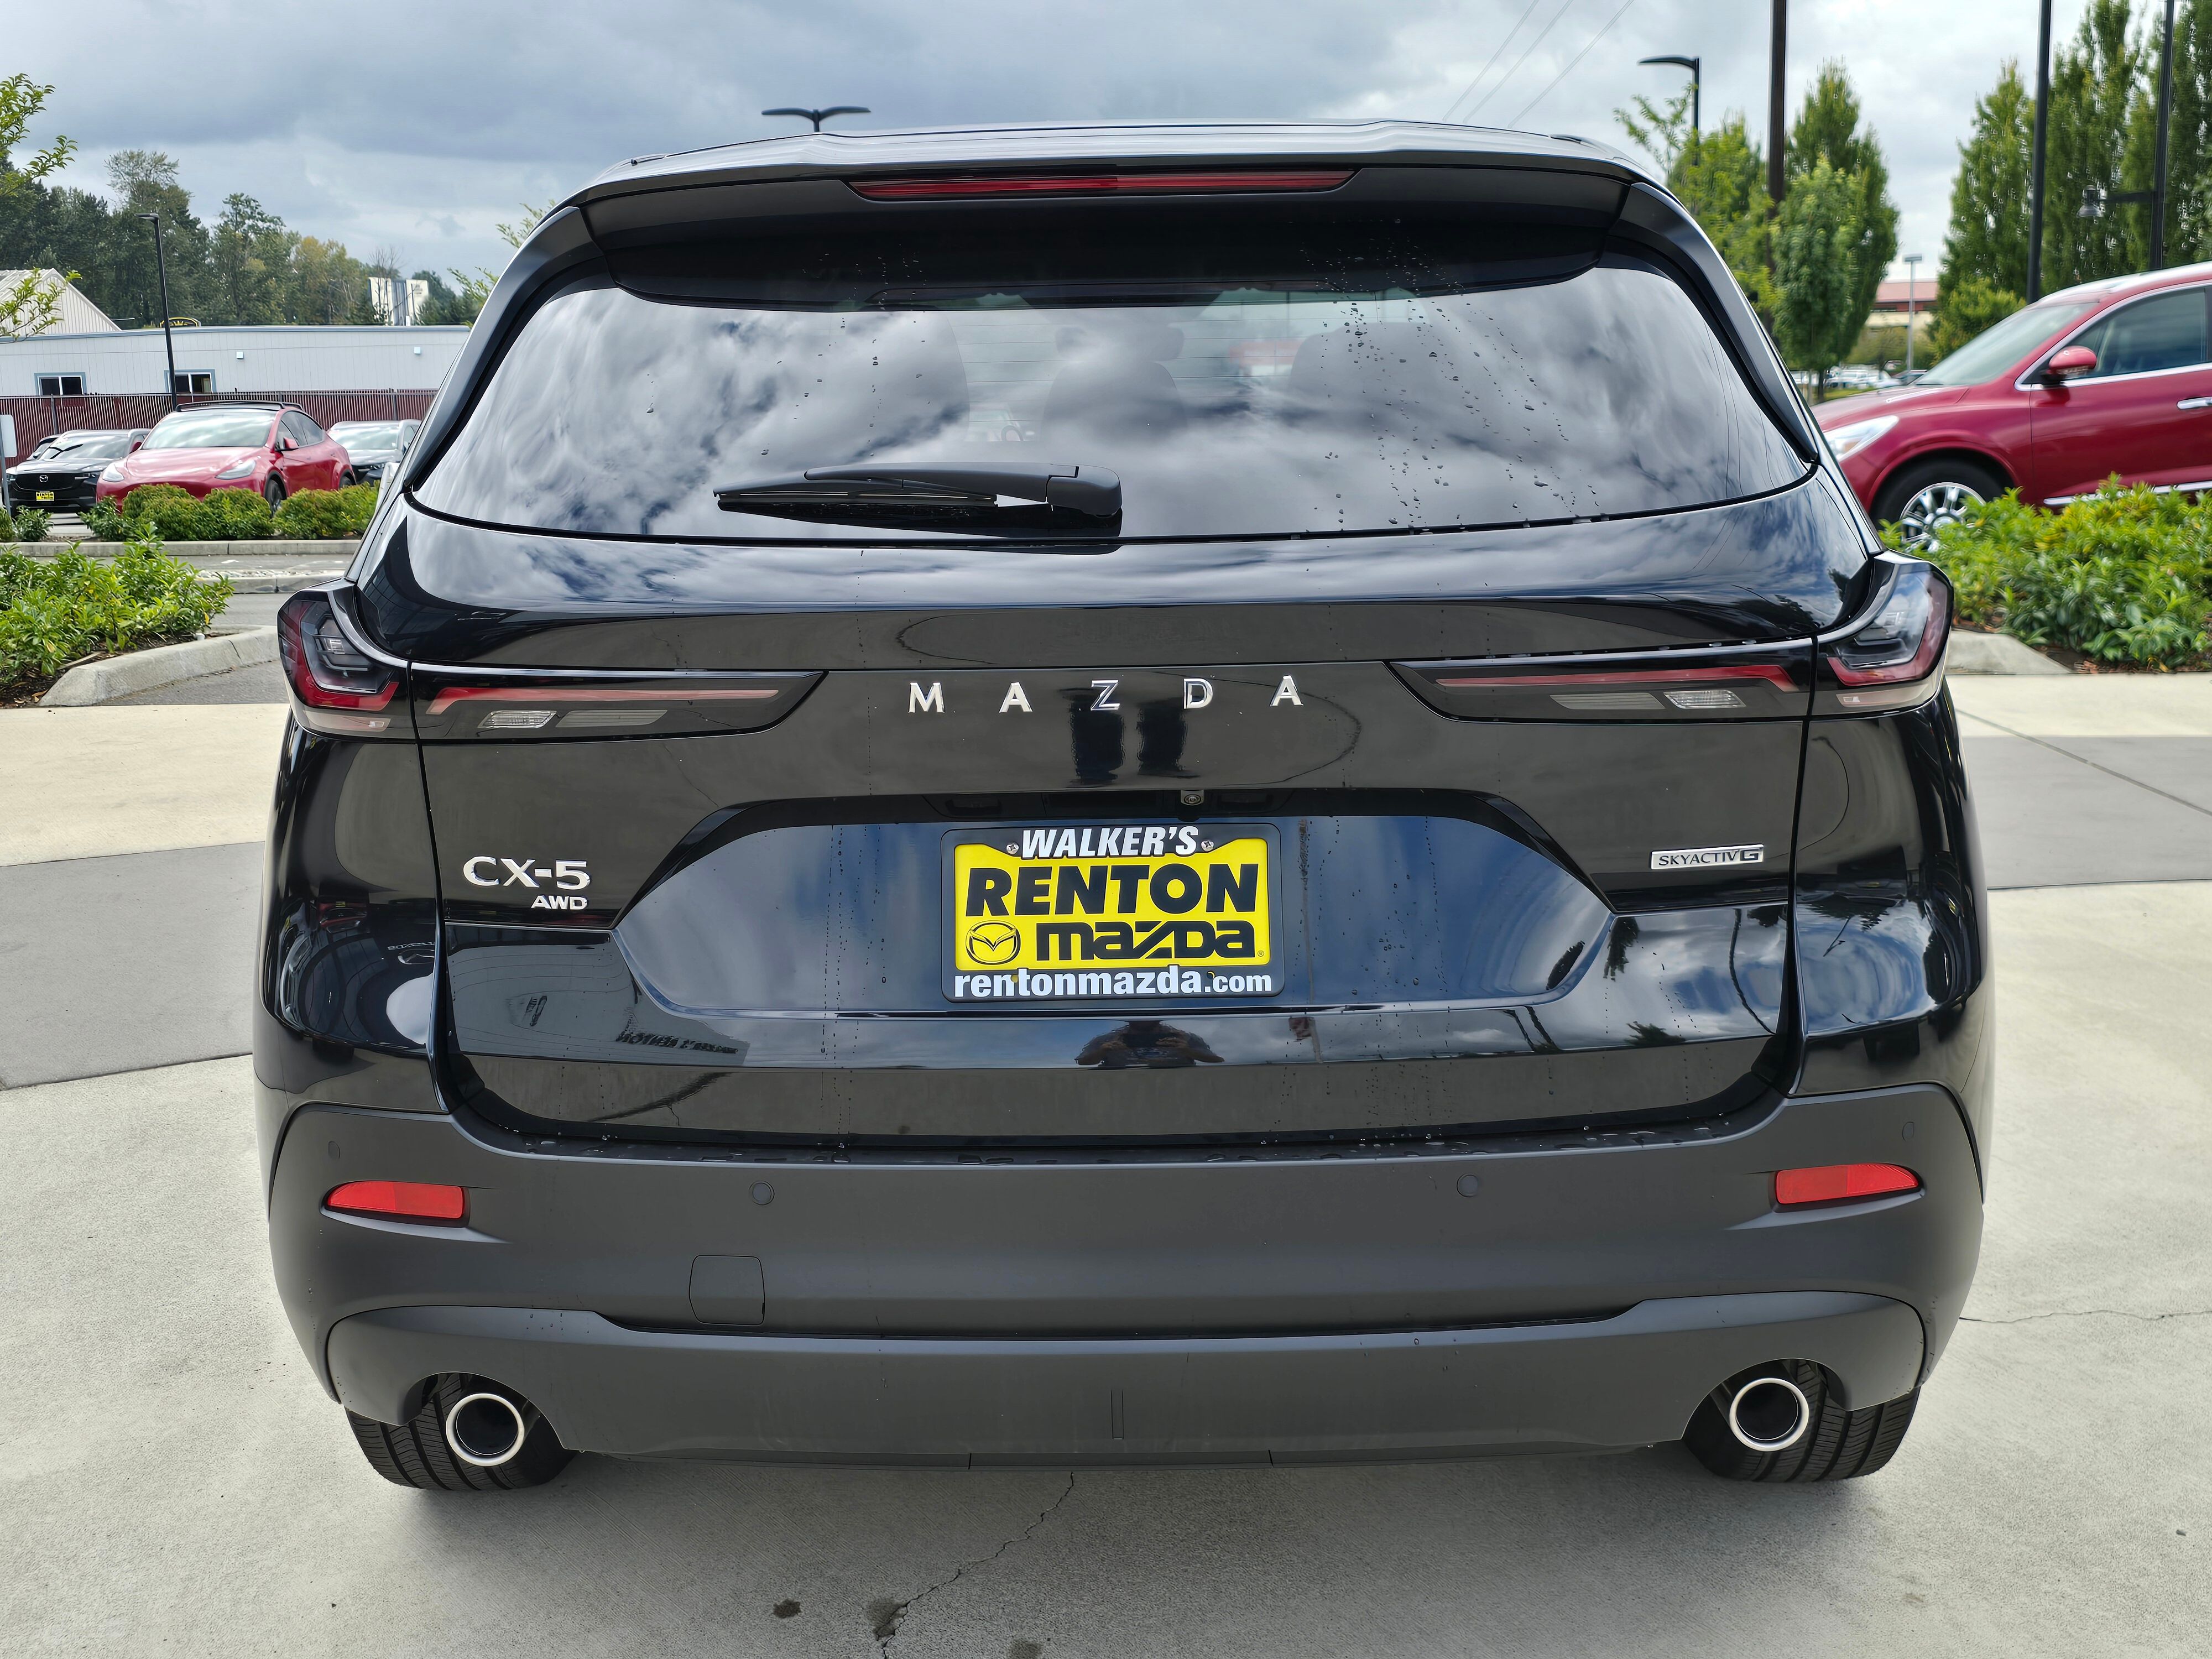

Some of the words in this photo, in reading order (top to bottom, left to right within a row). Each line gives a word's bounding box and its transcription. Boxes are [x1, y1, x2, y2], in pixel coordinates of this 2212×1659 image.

[908, 675, 1304, 713] MAZDA
[1021, 826, 1199, 858] WALKER'S
[463, 855, 591, 890] CX-5
[530, 894, 588, 910] AWD
[966, 863, 1259, 917] RENTON
[954, 966, 1272, 998] rentonmazda.com
